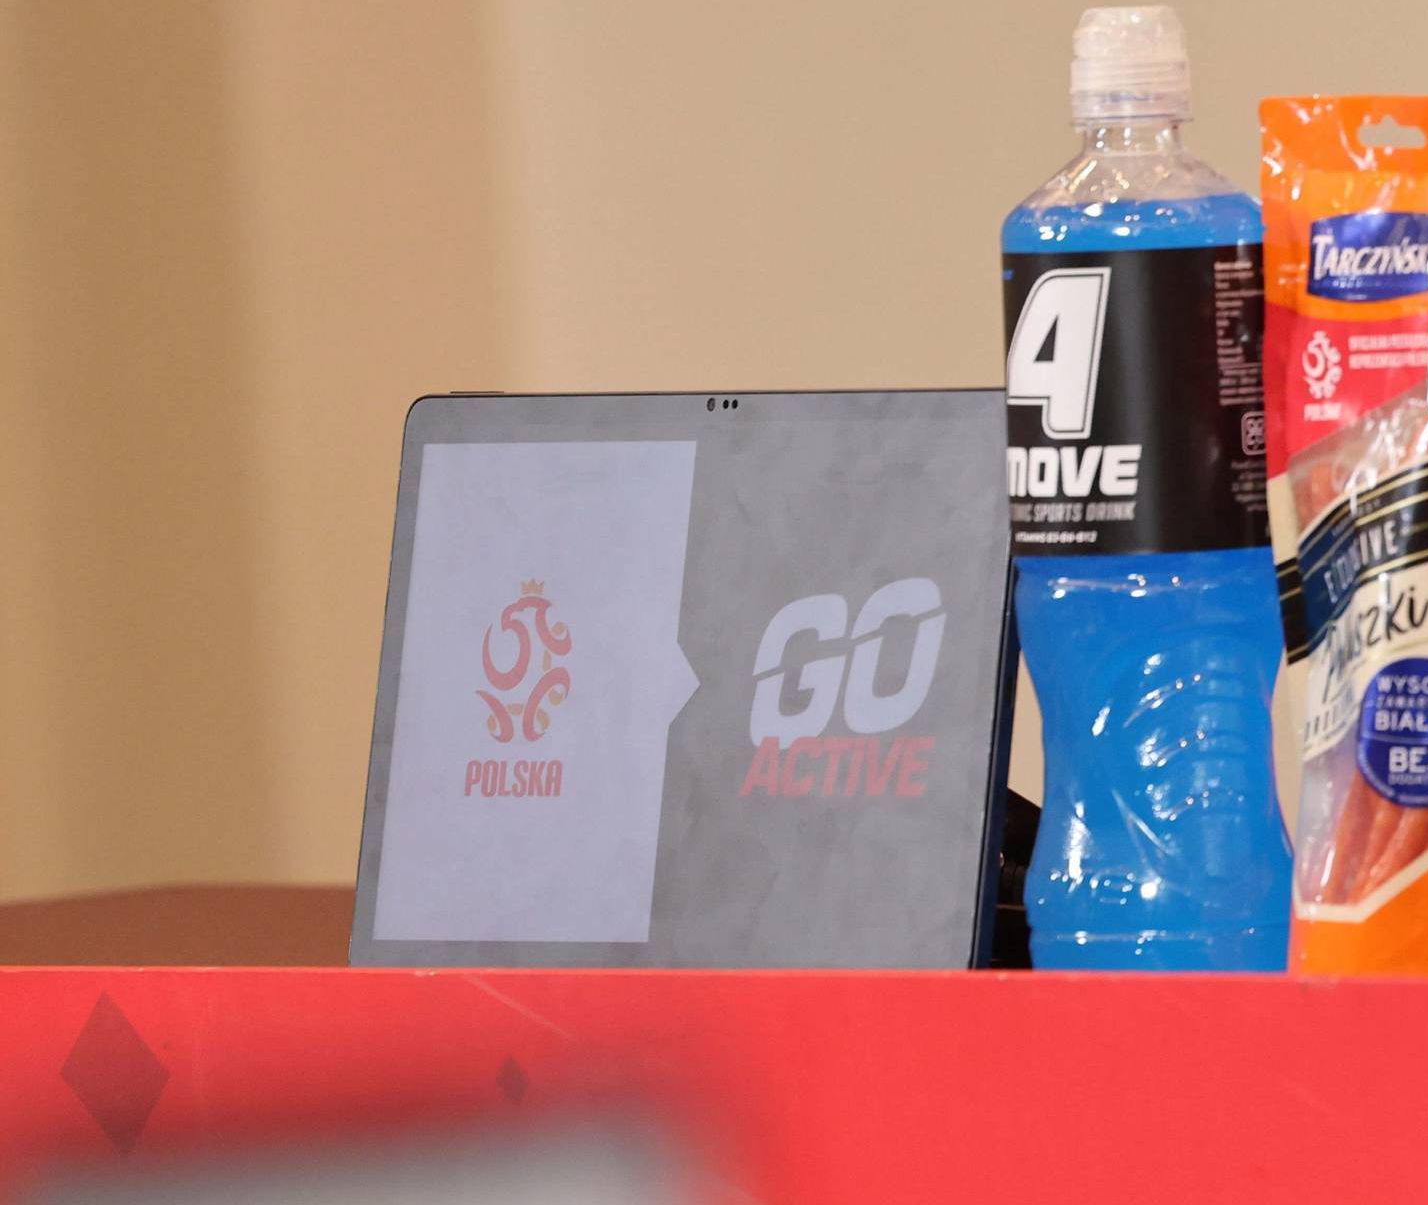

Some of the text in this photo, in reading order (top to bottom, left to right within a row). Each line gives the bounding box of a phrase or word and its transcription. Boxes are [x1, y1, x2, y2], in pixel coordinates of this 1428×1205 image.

[1007, 267, 1111, 439] 4
[750, 577, 947, 750] GO
[464, 759, 564, 798] POLSKA
[739, 735, 936, 797] ACTIVE
